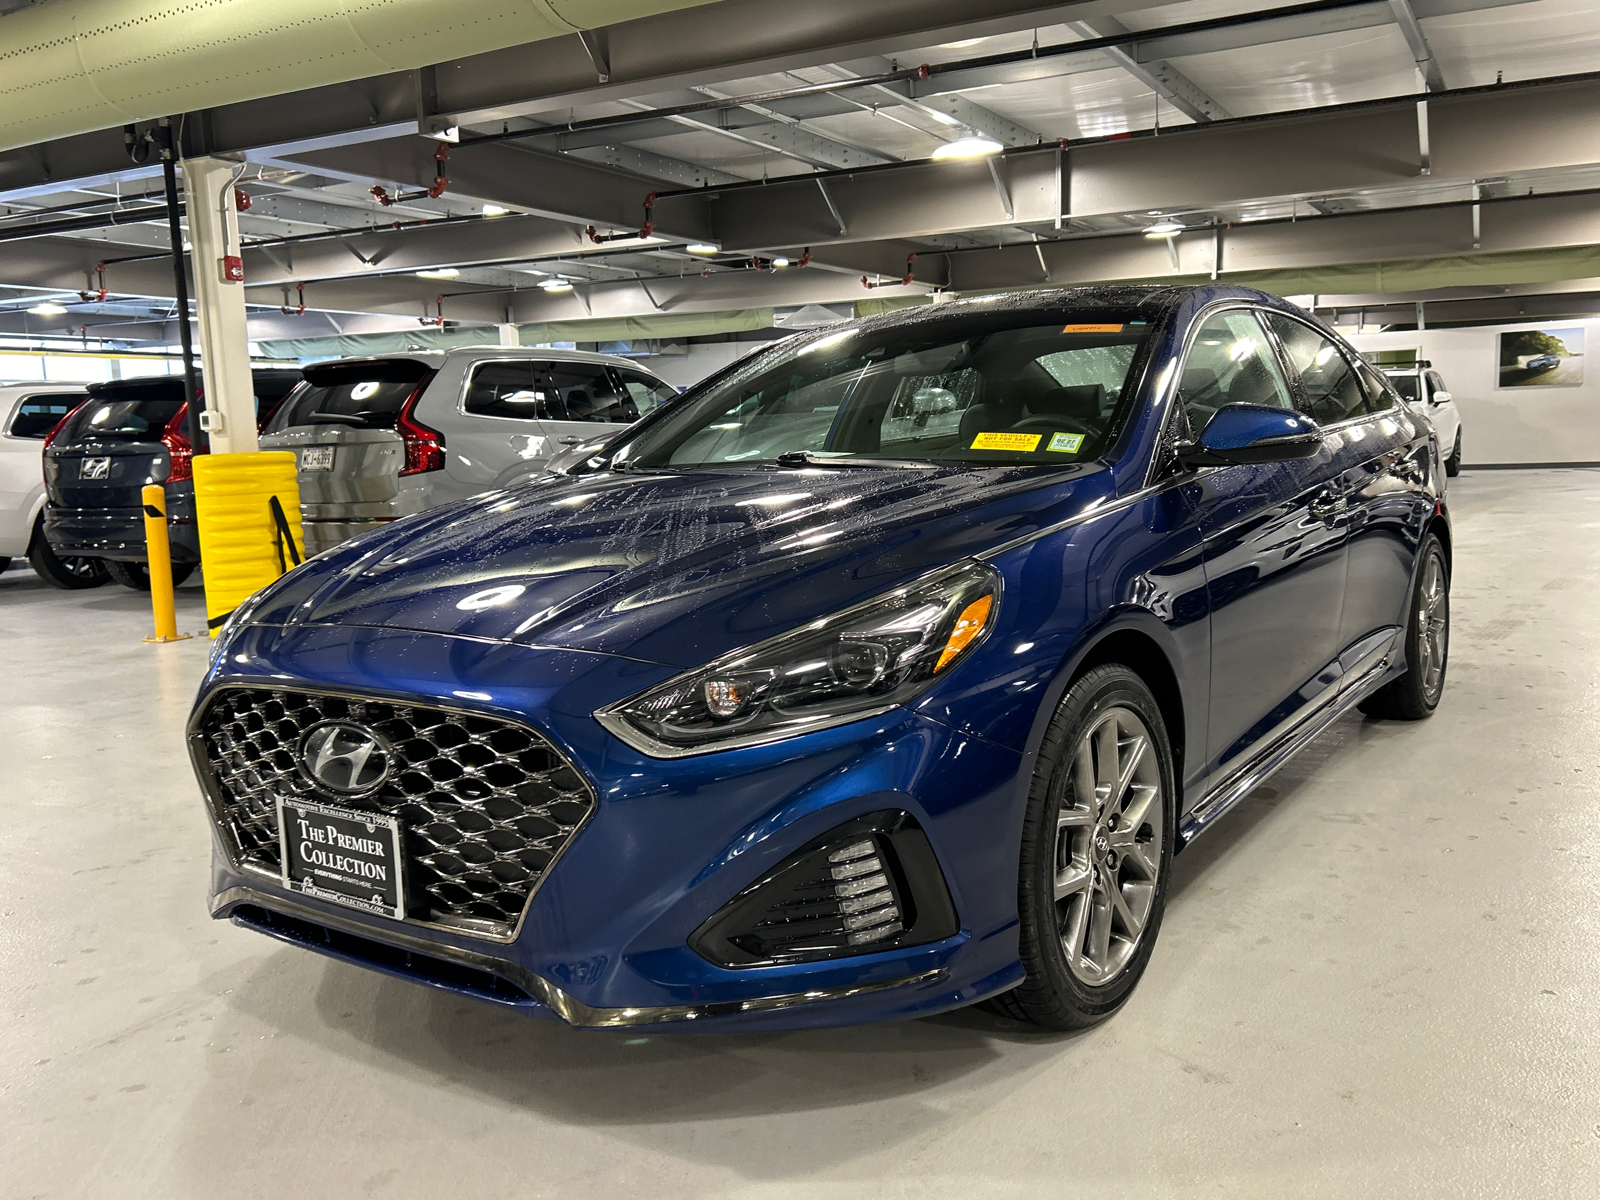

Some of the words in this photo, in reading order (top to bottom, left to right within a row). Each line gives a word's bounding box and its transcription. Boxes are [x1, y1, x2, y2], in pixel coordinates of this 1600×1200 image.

[297, 818, 327, 843] THE
[326, 825, 386, 857] PREMIER
[300, 841, 387, 881] COLLECTION
[313, 868, 343, 881] EVERYTHING
